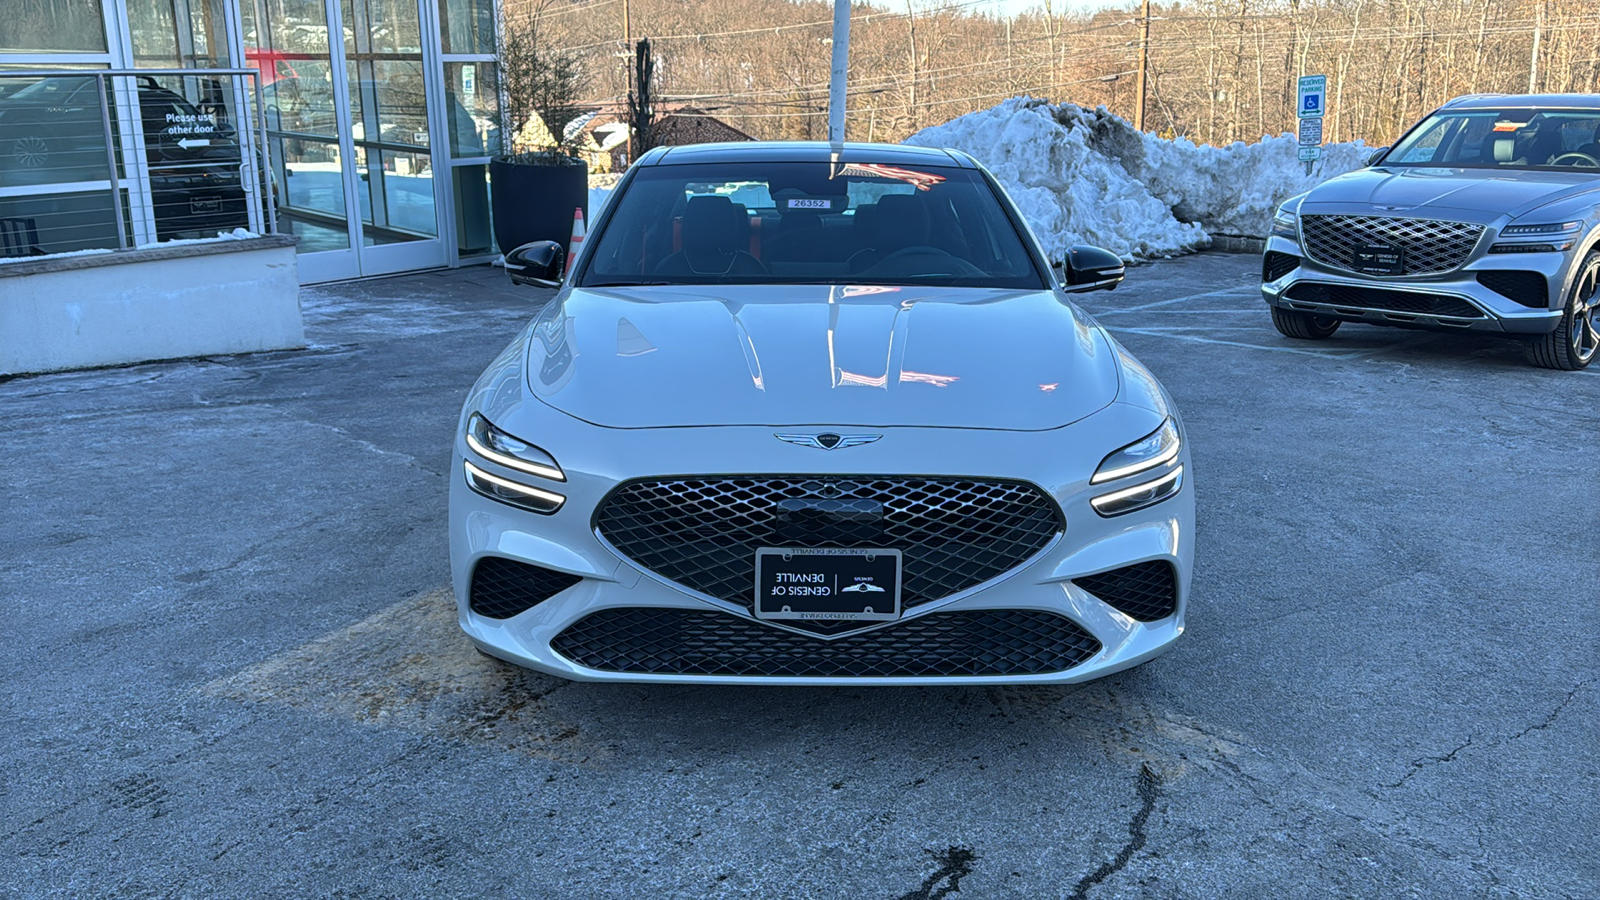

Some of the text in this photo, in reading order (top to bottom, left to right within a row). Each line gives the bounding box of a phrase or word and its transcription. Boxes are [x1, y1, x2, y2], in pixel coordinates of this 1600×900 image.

[165, 113, 196, 123] Please
[168, 124, 214, 135] other door
[776, 572, 825, 583] DENVILLE
[771, 585, 831, 596] GENESIS OF
